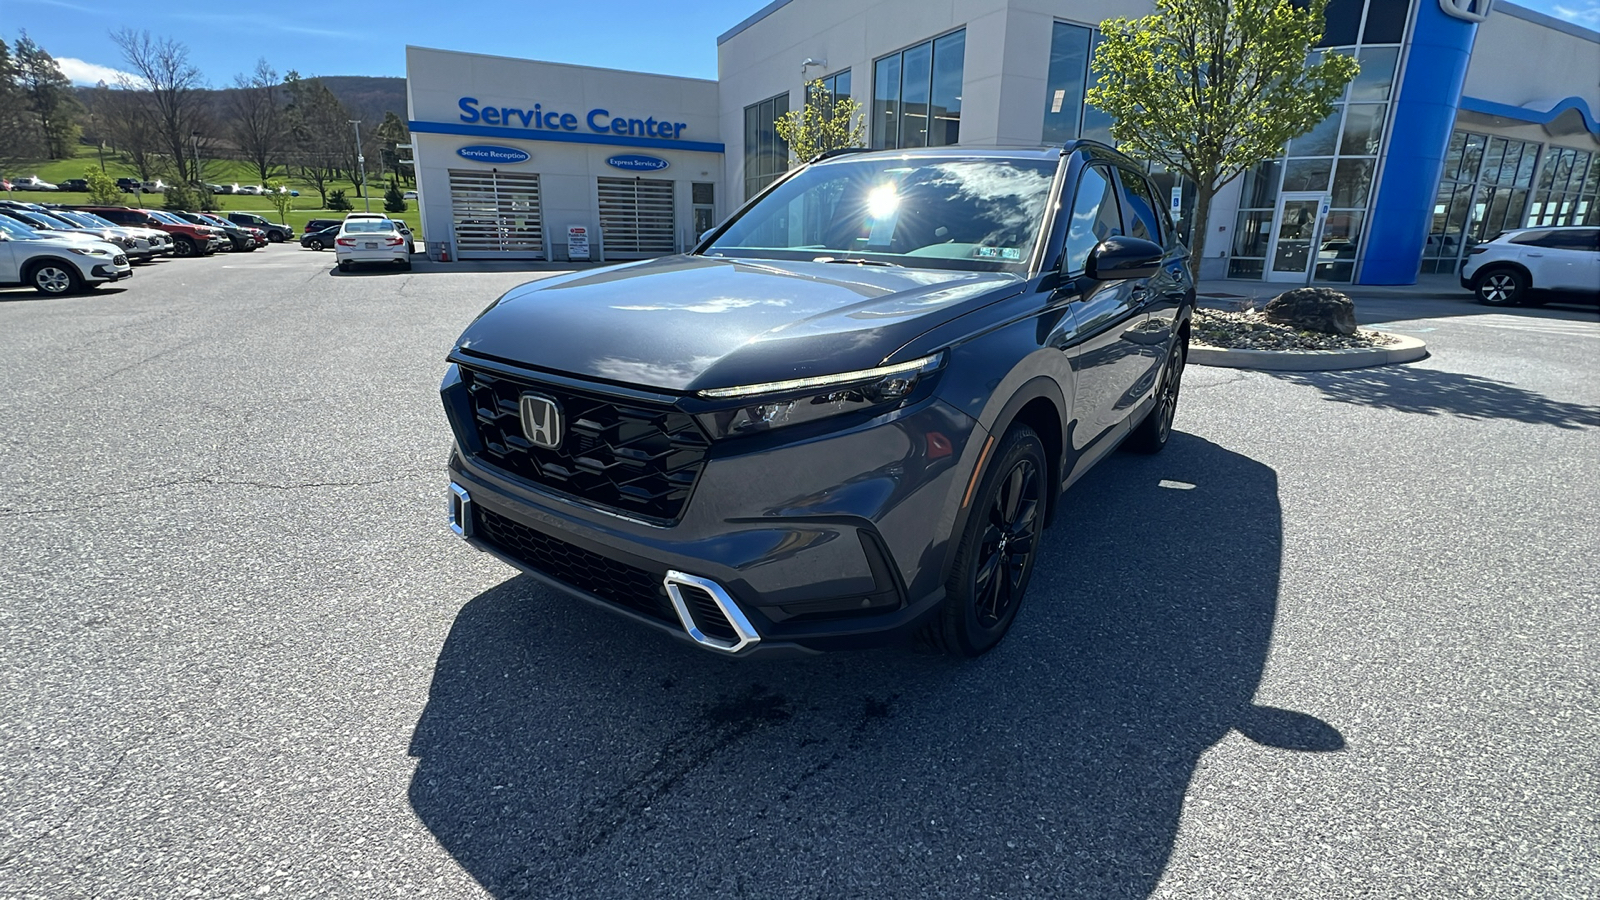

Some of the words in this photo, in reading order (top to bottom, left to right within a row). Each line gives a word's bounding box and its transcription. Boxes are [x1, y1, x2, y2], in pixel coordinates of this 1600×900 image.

[458, 97, 578, 130] Service
[586, 108, 687, 139] Center
[461, 149, 489, 157] Service
[490, 151, 526, 160] Reception
[610, 158, 634, 166] Express
